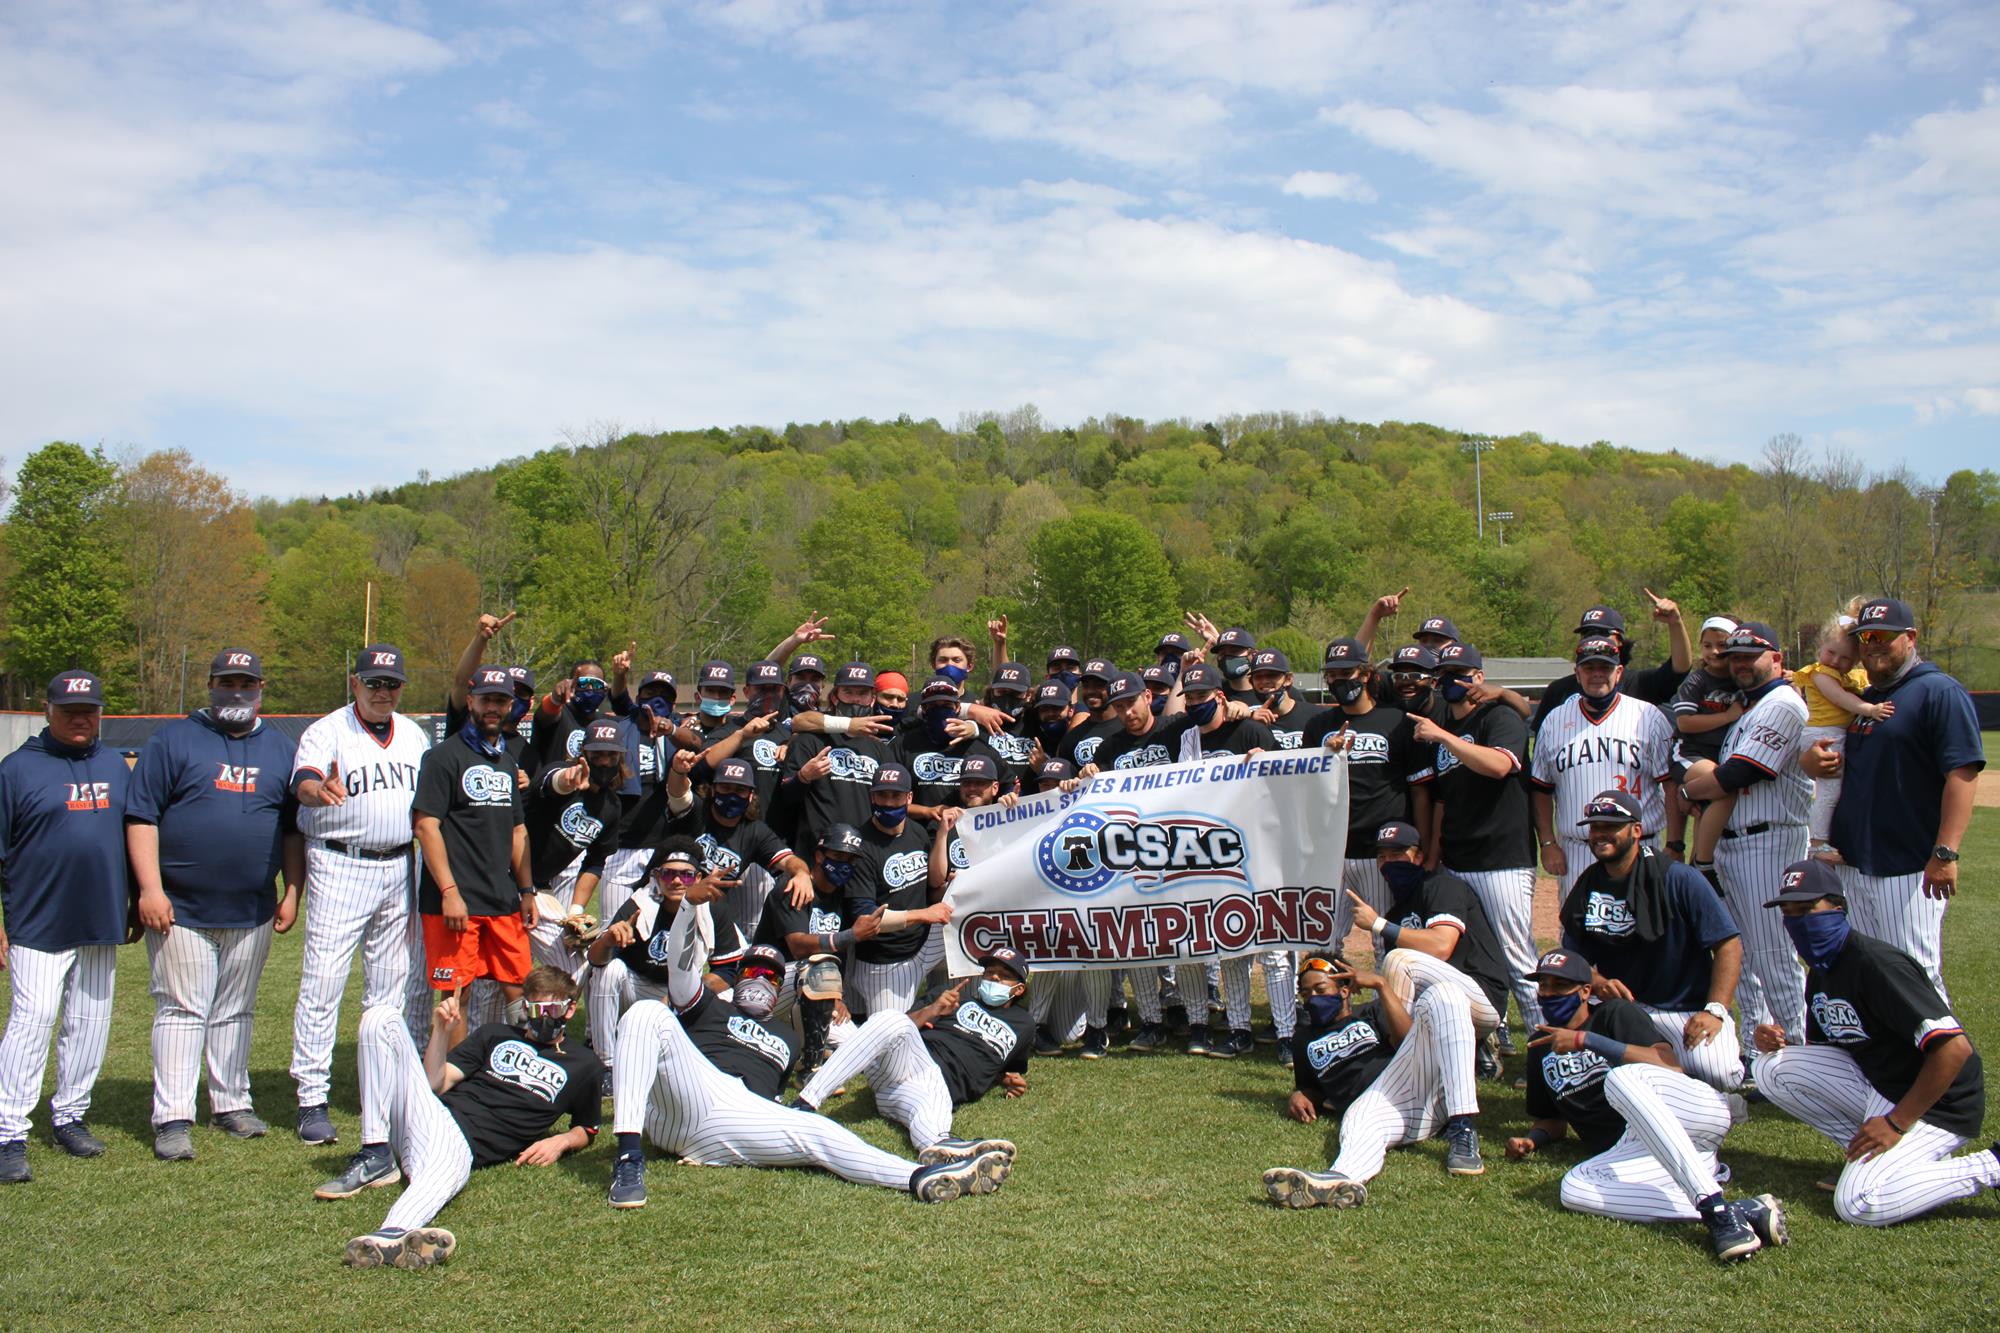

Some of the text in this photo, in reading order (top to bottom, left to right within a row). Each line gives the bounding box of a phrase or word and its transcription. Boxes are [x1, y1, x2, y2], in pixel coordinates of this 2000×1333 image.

[1583, 610, 1603, 621] KC
[1862, 606, 1889, 621] KC
[1424, 619, 1444, 630] KC
[1162, 634, 1180, 643] KC
[1220, 631, 1238, 642] KC
[1055, 648, 1071, 657] KC
[1328, 645, 1349, 659] KC
[1398, 647, 1420, 658] KC
[1441, 646, 1464, 658] KC
[226, 653, 252, 666] KC
[371, 652, 396, 665] KC
[800, 656, 818, 666] KC
[1255, 653, 1275, 665] KC
[709, 667, 728, 678] KC
[760, 666, 778, 676] KC
[1086, 662, 1104, 671] KC
[1143, 667, 1161, 677] KC
[482, 671, 506, 683] KC
[654, 672, 672, 682] KC
[848, 667, 868, 679] KC
[1001, 669, 1019, 680] KC
[1184, 670, 1203, 683] KC
[66, 679, 92, 692] KC
[1041, 686, 1058, 697] KC
[1110, 679, 1126, 695] KC
[595, 727, 616, 738] KC
[1751, 726, 1788, 751] KC
[1133, 746, 1169, 767] CSAC
[1555, 737, 1642, 773] GIANTS
[725, 765, 745, 777] KC
[965, 760, 984, 770] KC
[1044, 761, 1063, 772] KC
[346, 762, 417, 797] GIANT
[880, 770, 900, 781] KC
[974, 800, 1055, 831] COLONIAL
[1119, 767, 1204, 793] ATHLETIC
[1210, 755, 1333, 785] CONFERENCE
[842, 831, 863, 847] KC
[1377, 827, 1399, 841] KC
[1099, 822, 1246, 872] CSAC
[960, 887, 1335, 963] CHAMPIONS
[753, 946, 777, 957] KC
[993, 948, 1016, 959] KC
[432, 967, 454, 980] KC
[1327, 1024, 1374, 1052] CSAC
[514, 1051, 566, 1090] CSAC
